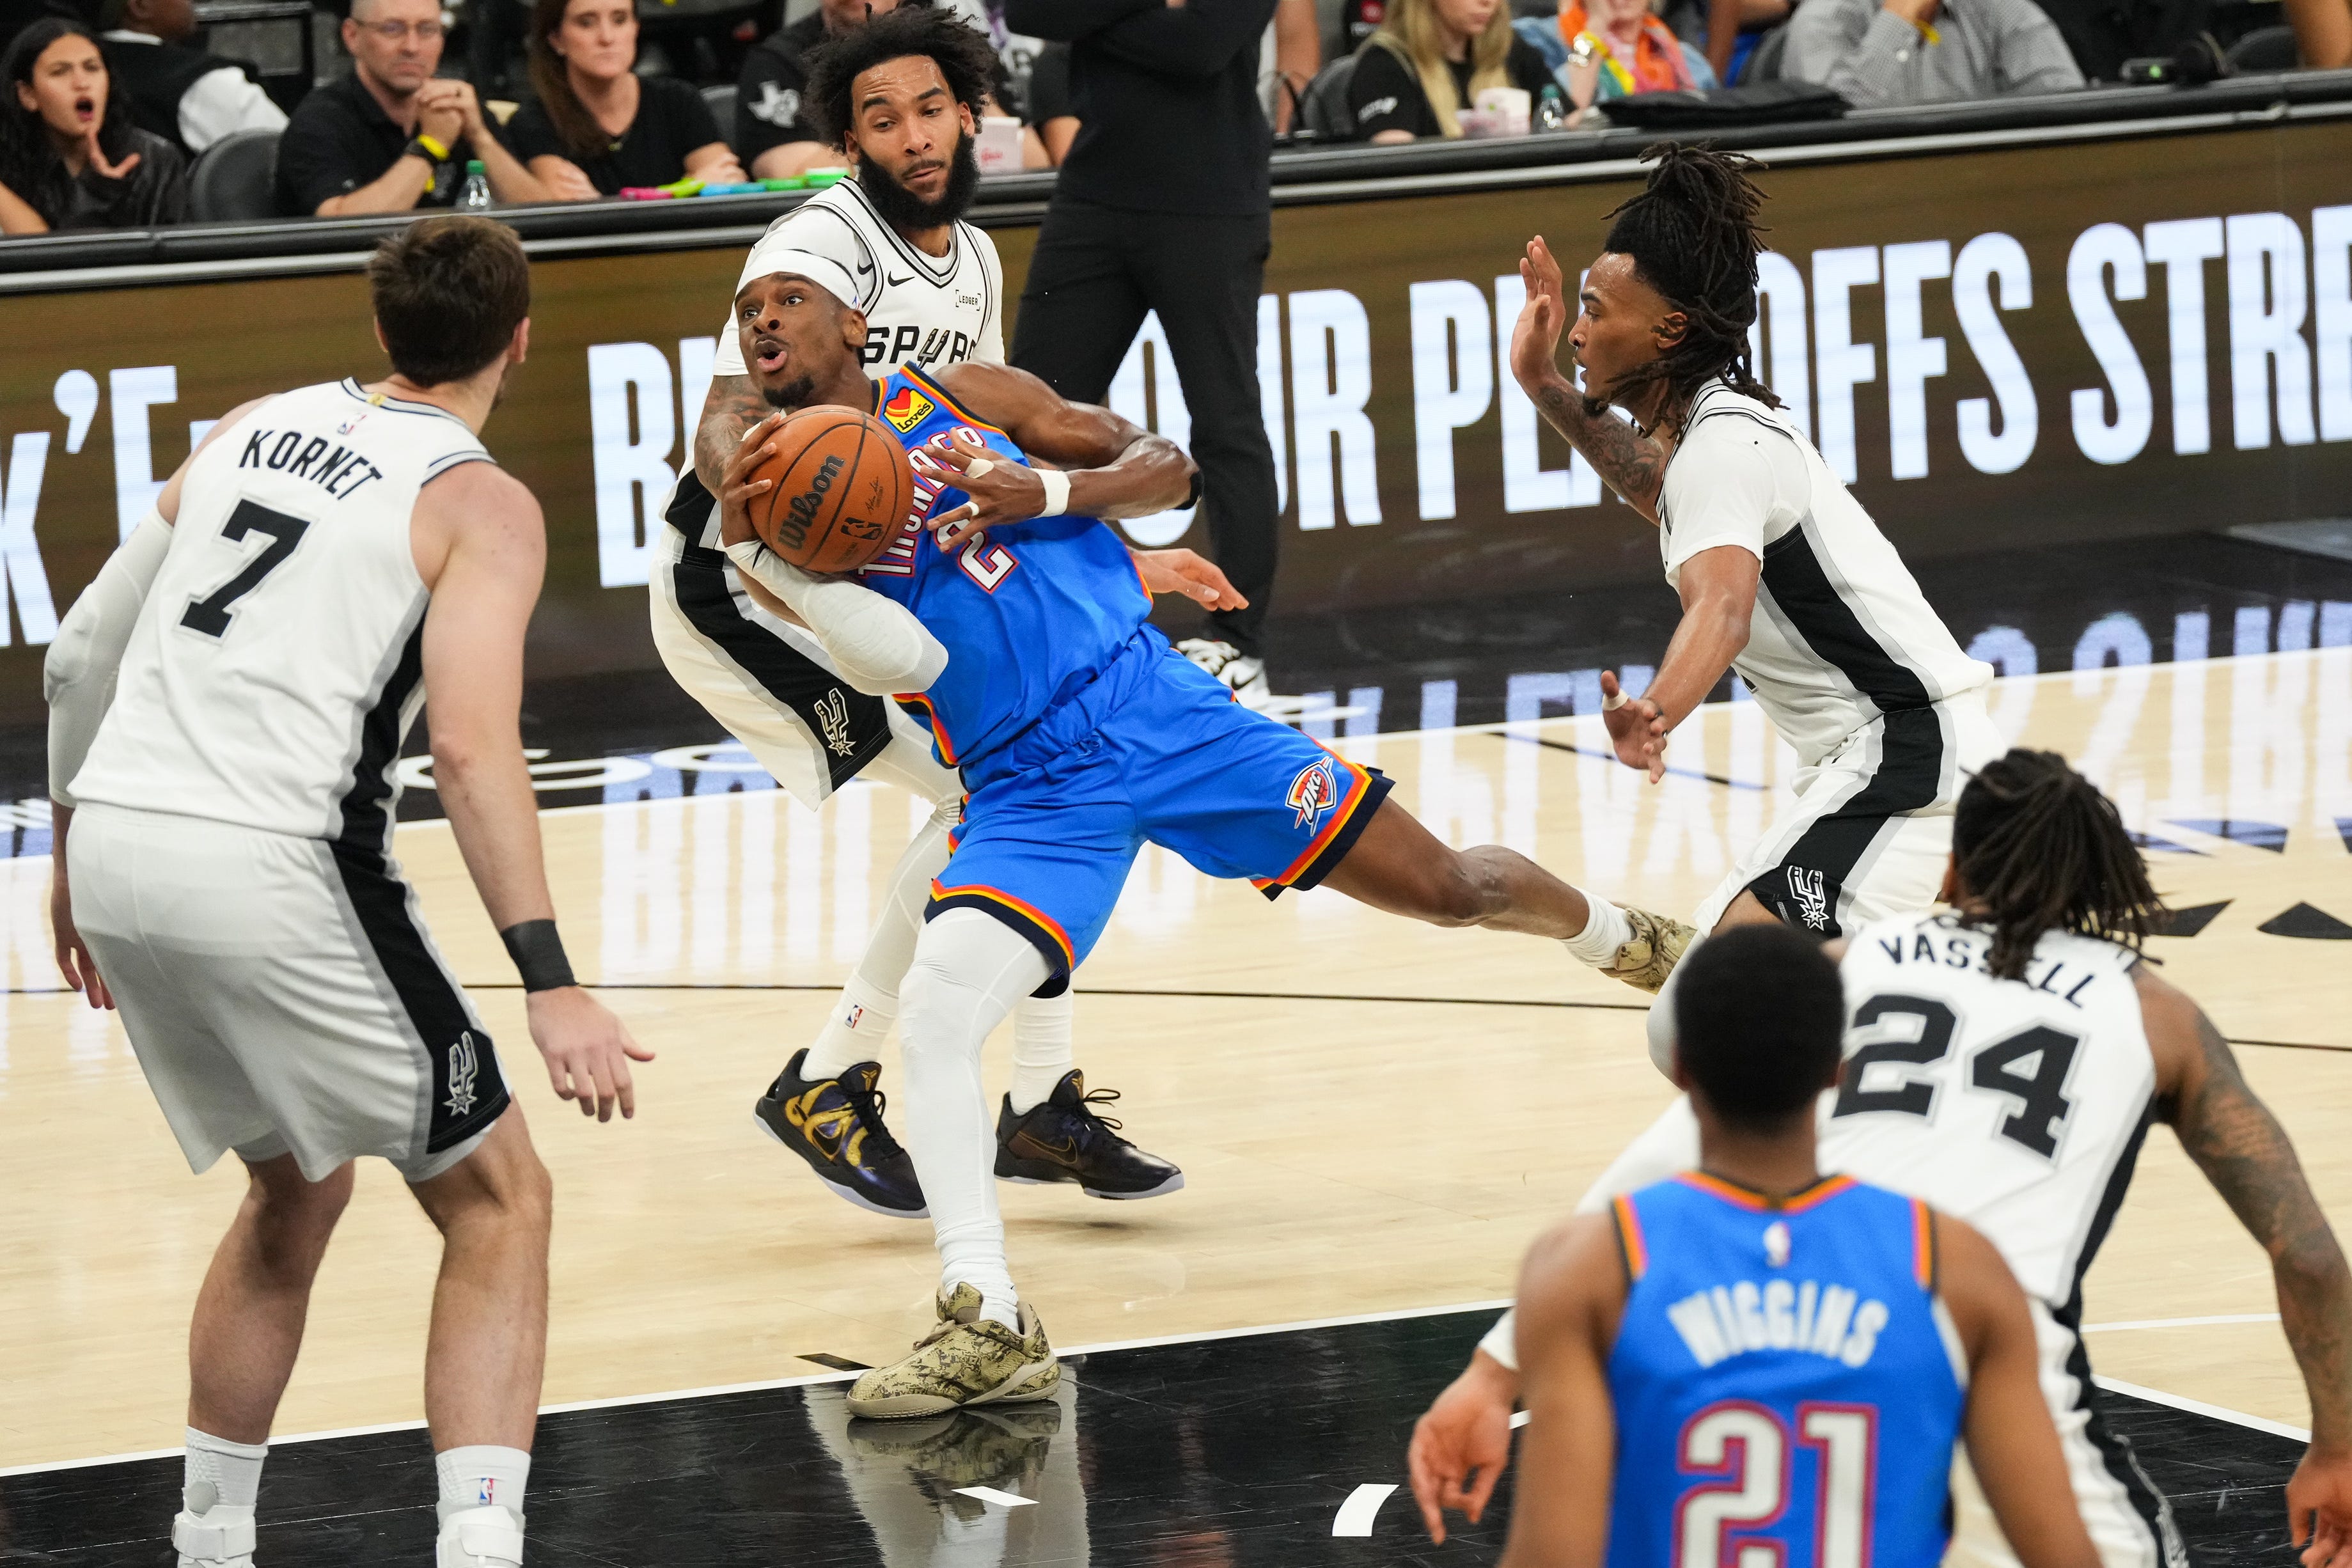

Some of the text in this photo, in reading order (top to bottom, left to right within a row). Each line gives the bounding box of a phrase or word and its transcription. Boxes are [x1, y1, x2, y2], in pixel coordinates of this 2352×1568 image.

[959, 294, 978, 306] LEDGER
[864, 325, 978, 369] SPUR
[239, 429, 383, 501] KORNET
[778, 455, 846, 551] Wilson
[174, 494, 319, 643] 7
[934, 519, 1020, 594] 2
[1301, 771, 1322, 821] OKC
[1879, 934, 2095, 1008] VASLL
[1832, 990, 2086, 1165] 24
[1666, 1279, 1890, 1368] WIGGINS
[1670, 1399, 1881, 1568] 21
